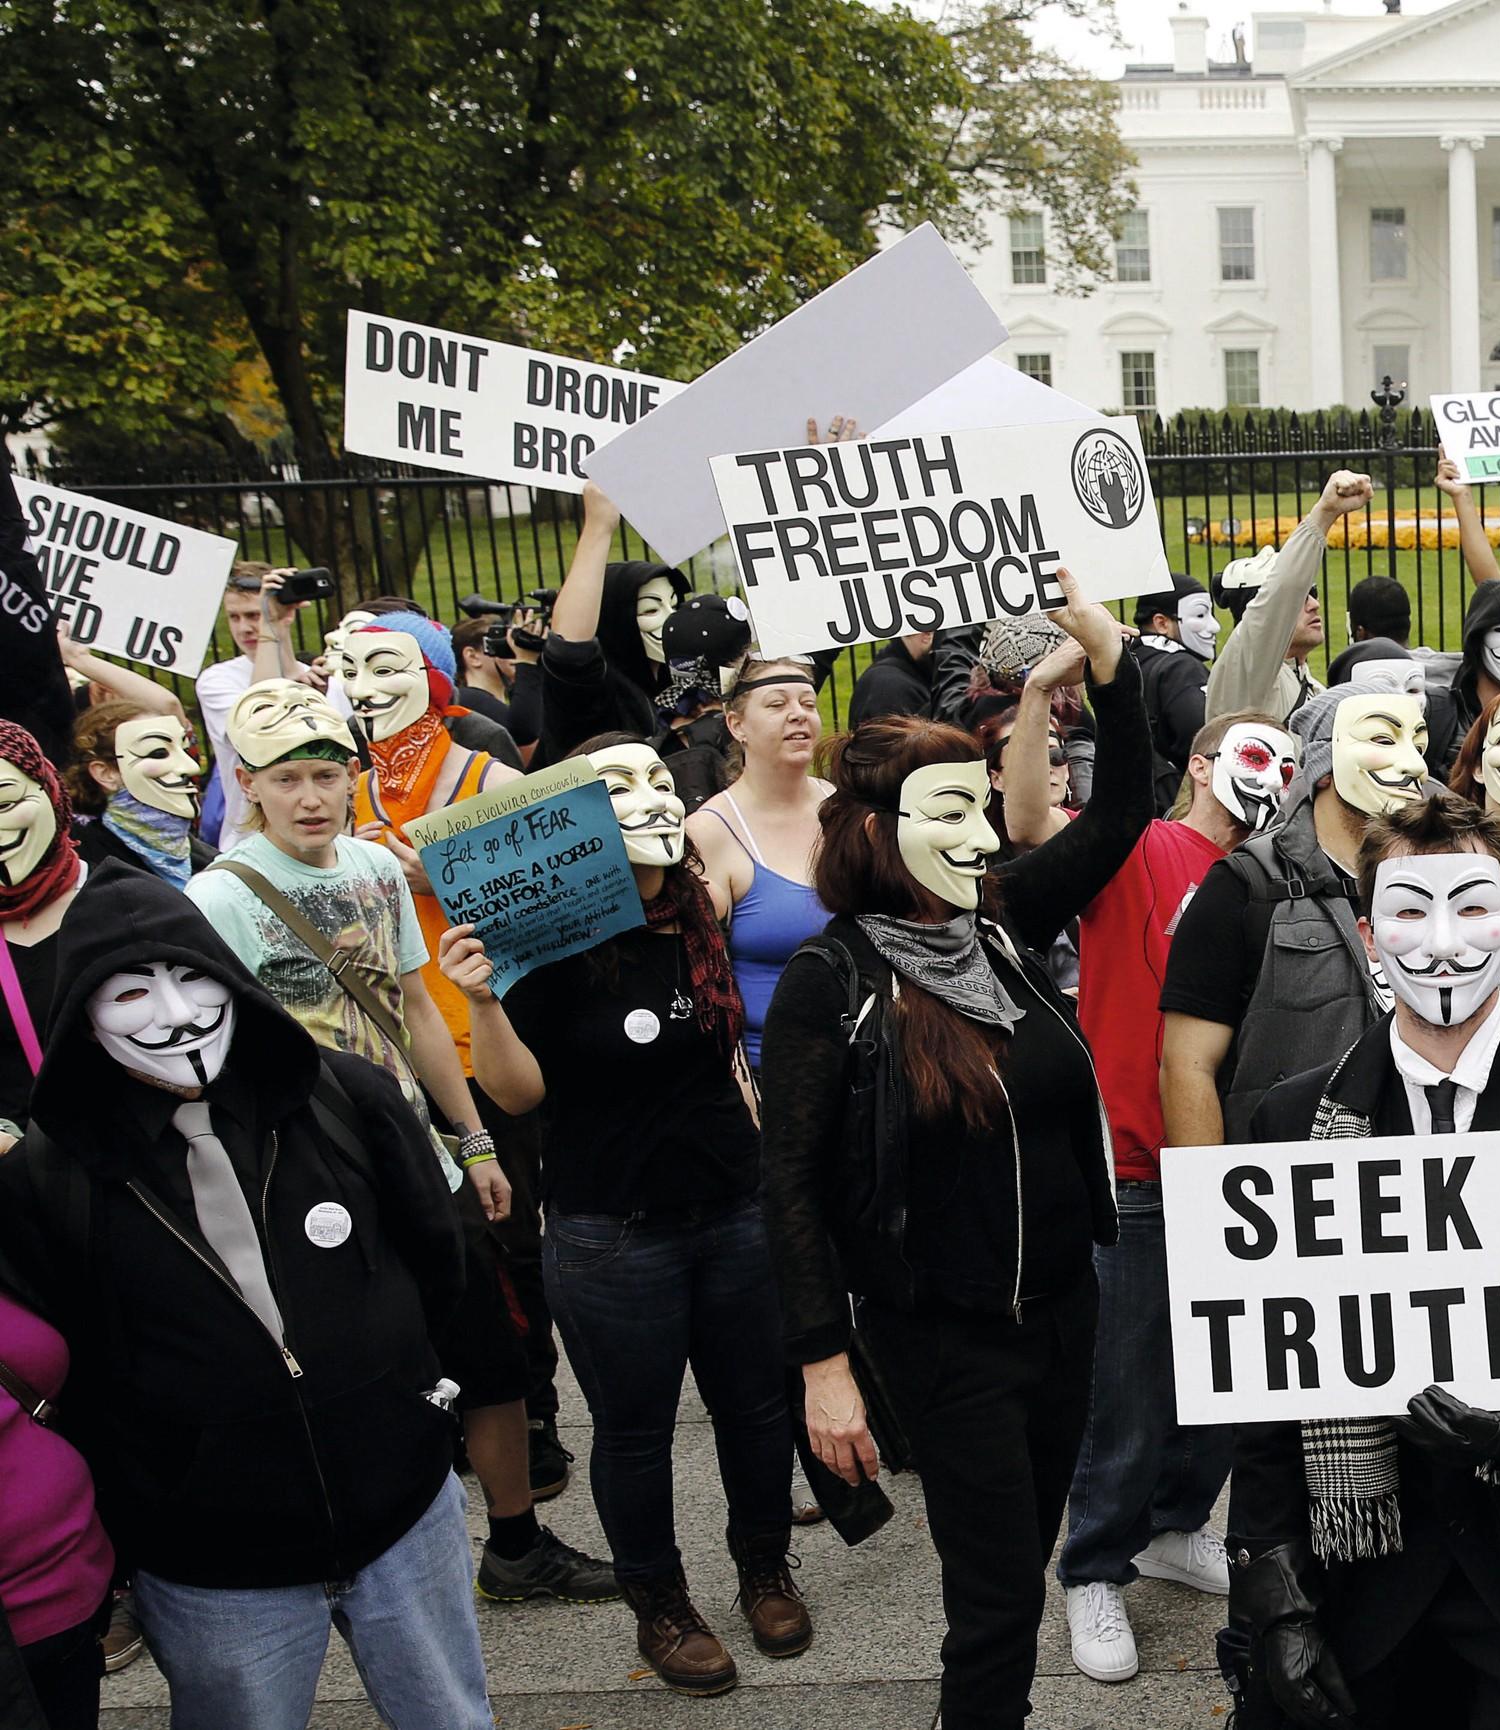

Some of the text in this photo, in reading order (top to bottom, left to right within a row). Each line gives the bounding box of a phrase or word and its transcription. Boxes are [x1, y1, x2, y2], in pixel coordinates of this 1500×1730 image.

[366, 323, 488, 392] DONT
[398, 401, 463, 458] ME
[736, 435, 963, 516] TRUTH
[26, 495, 181, 576] SHOULD
[732, 494, 1045, 587] FREEDOM
[36, 544, 99, 601] AVE
[827, 551, 1068, 644] JUSTICE
[126, 616, 183, 667] US
[504, 819, 525, 857] of
[523, 806, 578, 841] FEAR
[443, 837, 604, 912] WE HAVE A WORLD
[450, 873, 565, 927] VISION FOR A
[471, 910, 513, 939] aceful
[1222, 1155, 1483, 1260] SEEK
